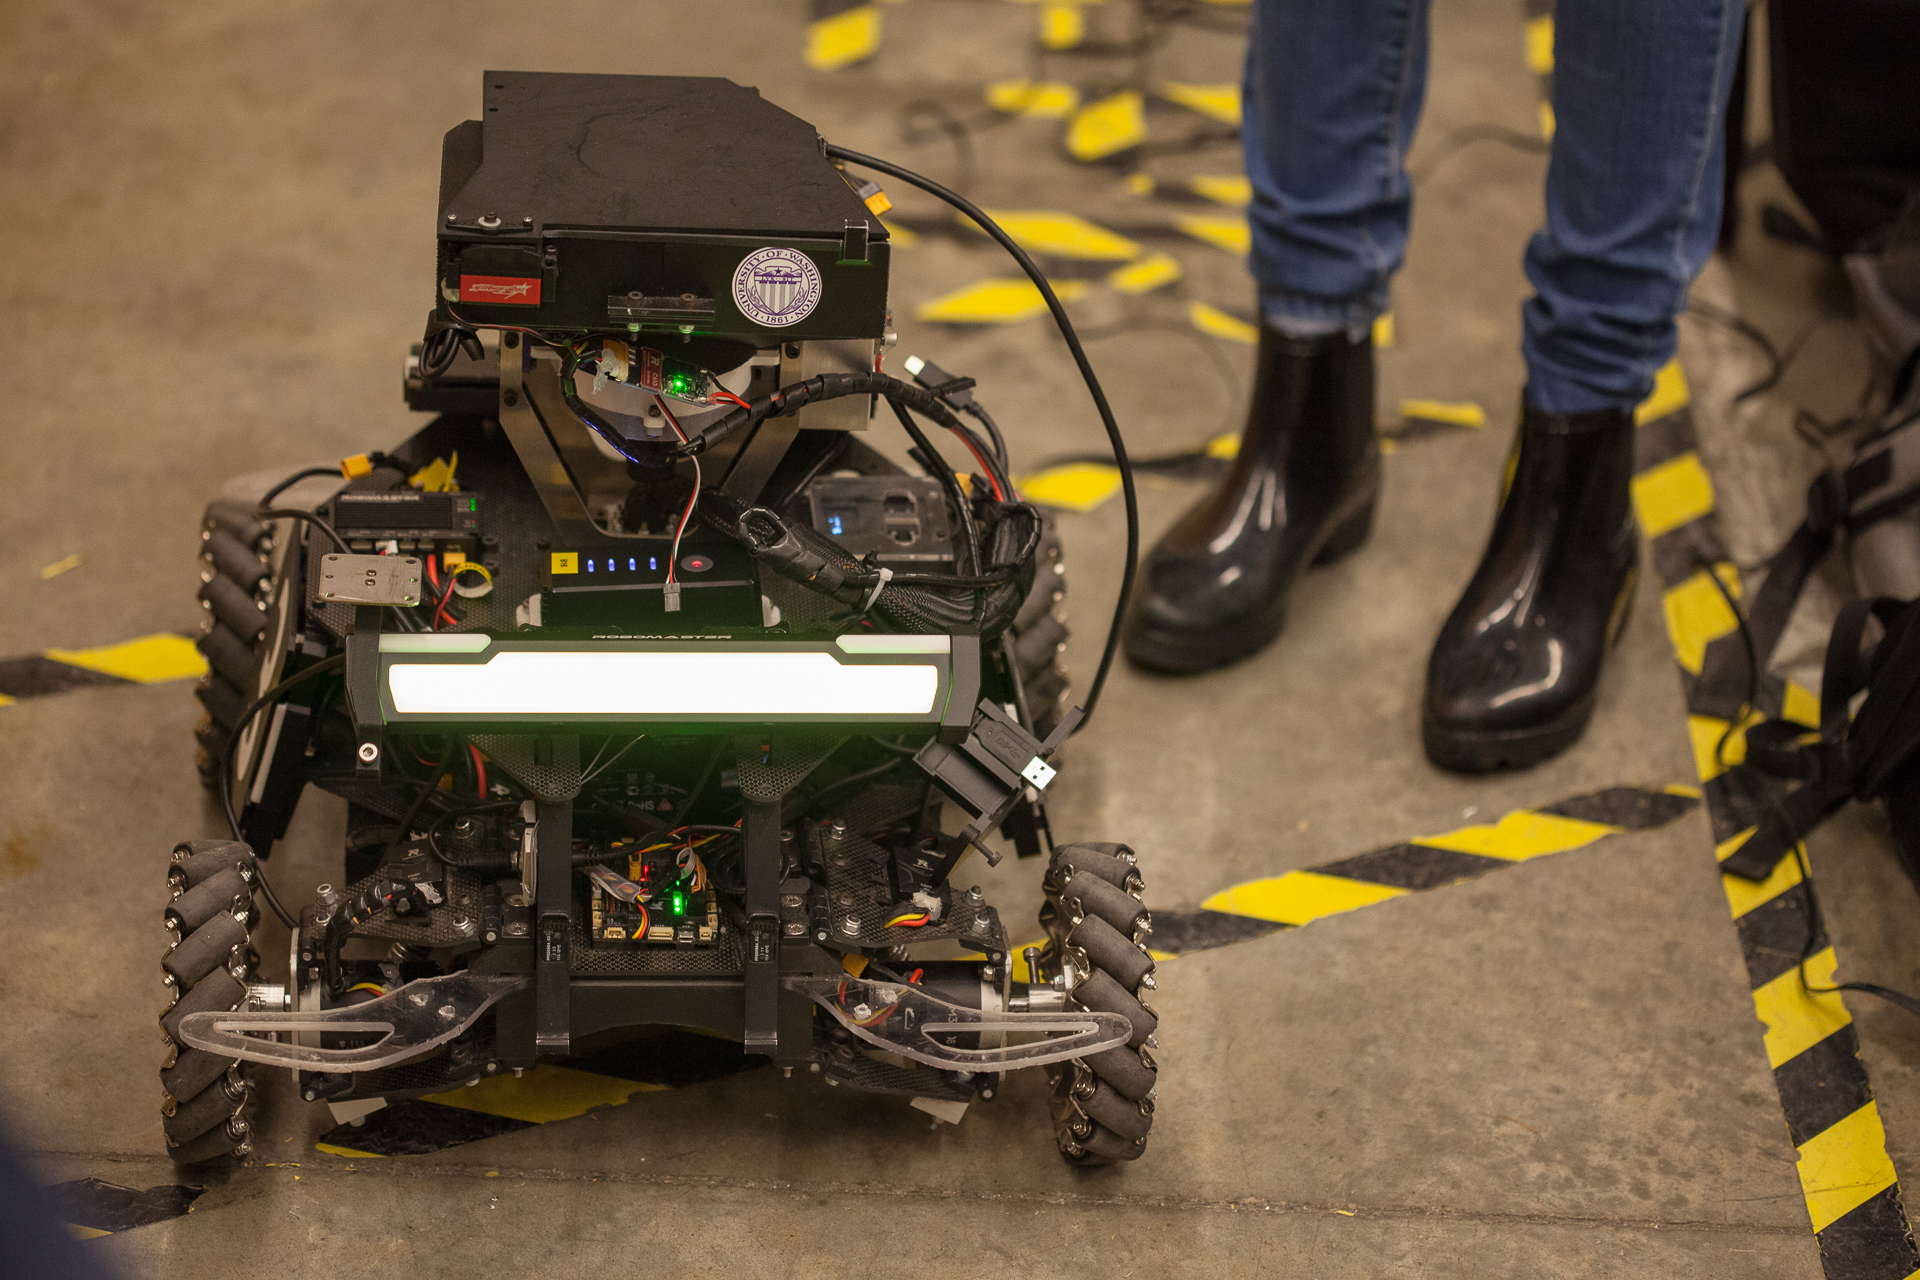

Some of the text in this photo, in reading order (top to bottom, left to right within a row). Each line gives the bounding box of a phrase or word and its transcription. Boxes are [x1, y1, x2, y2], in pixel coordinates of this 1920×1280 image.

[737, 250, 818, 318] UNIVERSITY OF WASHINGTON
[765, 315, 789, 324] 1861
